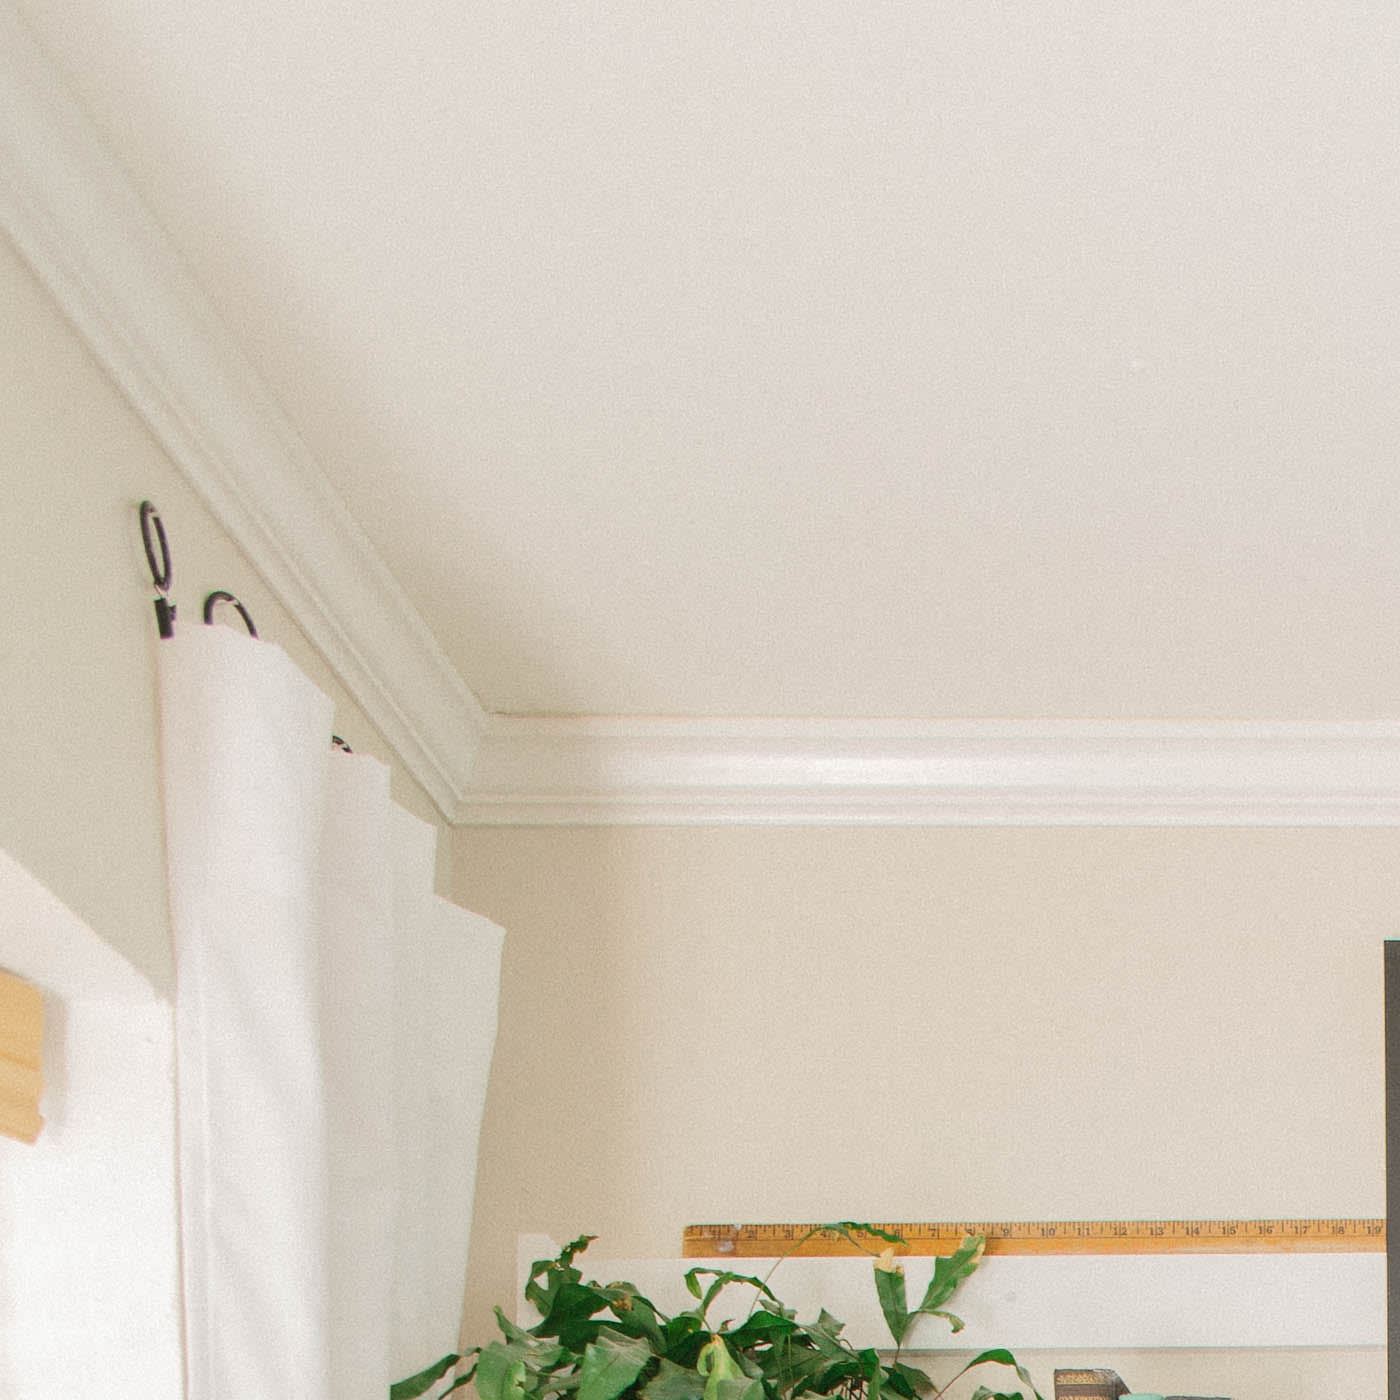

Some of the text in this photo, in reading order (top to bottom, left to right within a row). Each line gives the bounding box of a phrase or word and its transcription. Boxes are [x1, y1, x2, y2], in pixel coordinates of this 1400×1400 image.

[1041, 1228, 1056, 1236] 10
[1077, 1227, 1091, 1236] 11
[1113, 1227, 1128, 1236] 12
[1150, 1227, 1164, 1236] 13
[1185, 1226, 1200, 1235] 14
[1222, 1226, 1237, 1235] 15
[1258, 1225, 1274, 1235] 16
[1294, 1225, 1311, 1234] 17
[1332, 1225, 1345, 1235] 18
[1367, 1225, 1382, 1234] 19
